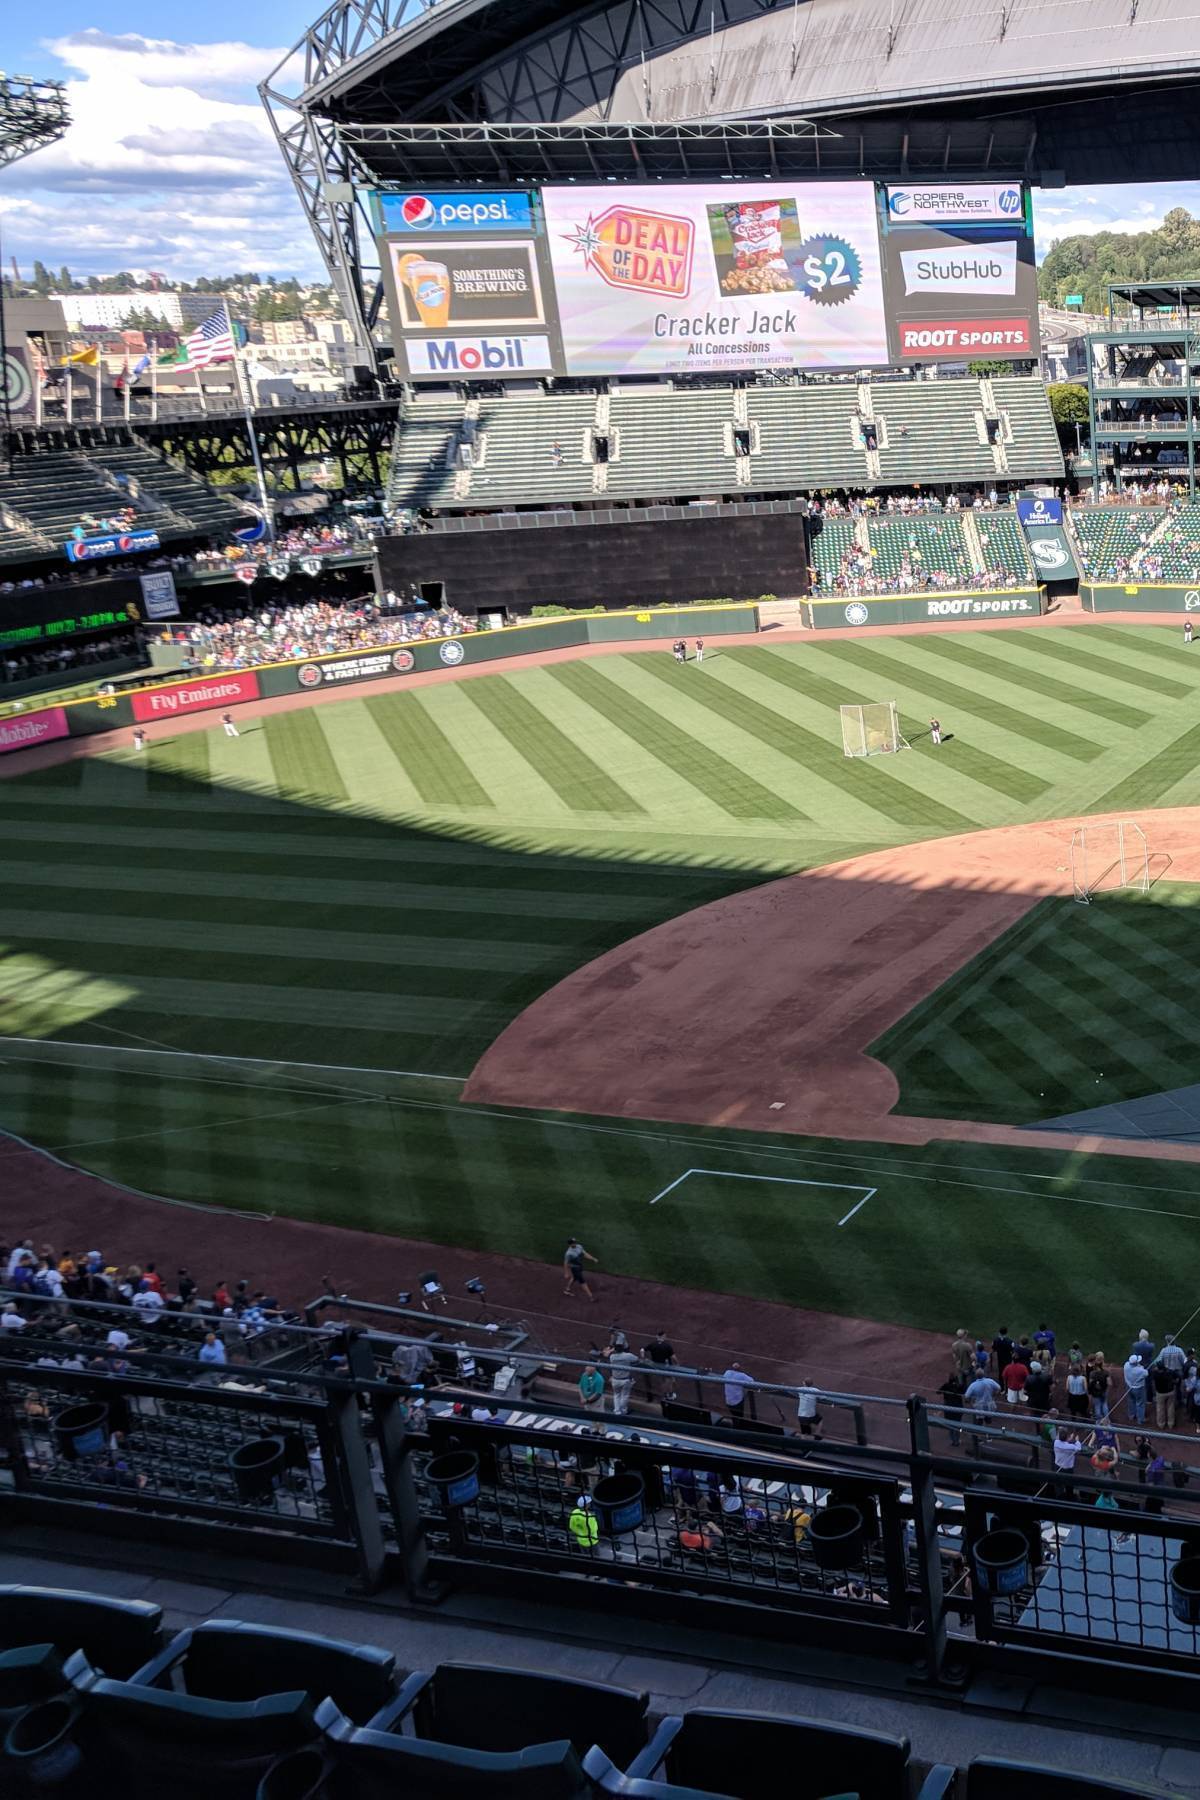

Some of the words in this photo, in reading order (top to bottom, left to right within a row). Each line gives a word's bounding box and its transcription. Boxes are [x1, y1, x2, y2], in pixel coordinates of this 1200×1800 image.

[913, 193, 964, 201] COPIERS
[913, 200, 989, 209] NORTHWEST
[1001, 190, 1018, 213] hp
[440, 199, 508, 225] pepsi
[615, 216, 685, 256] DEAL
[613, 249, 632, 266] OF
[452, 268, 525, 282] SOMETHING'S
[612, 266, 630, 279] THE
[632, 252, 683, 287] DAY
[803, 251, 851, 292] $2
[917, 260, 1002, 280] StubHub
[654, 312, 740, 337] Cracker
[747, 309, 797, 334] Jack
[687, 342, 703, 355] All
[705, 341, 770, 355] Concessions
[904, 329, 958, 348] ROOT
[959, 330, 1024, 346] SPORTS
[426, 338, 524, 370] Mobil
[927, 600, 974, 615] ROOT
[973, 599, 1028, 613] SPORTS
[151, 694, 178, 711] Fly
[178, 682, 242, 705] Emirates
